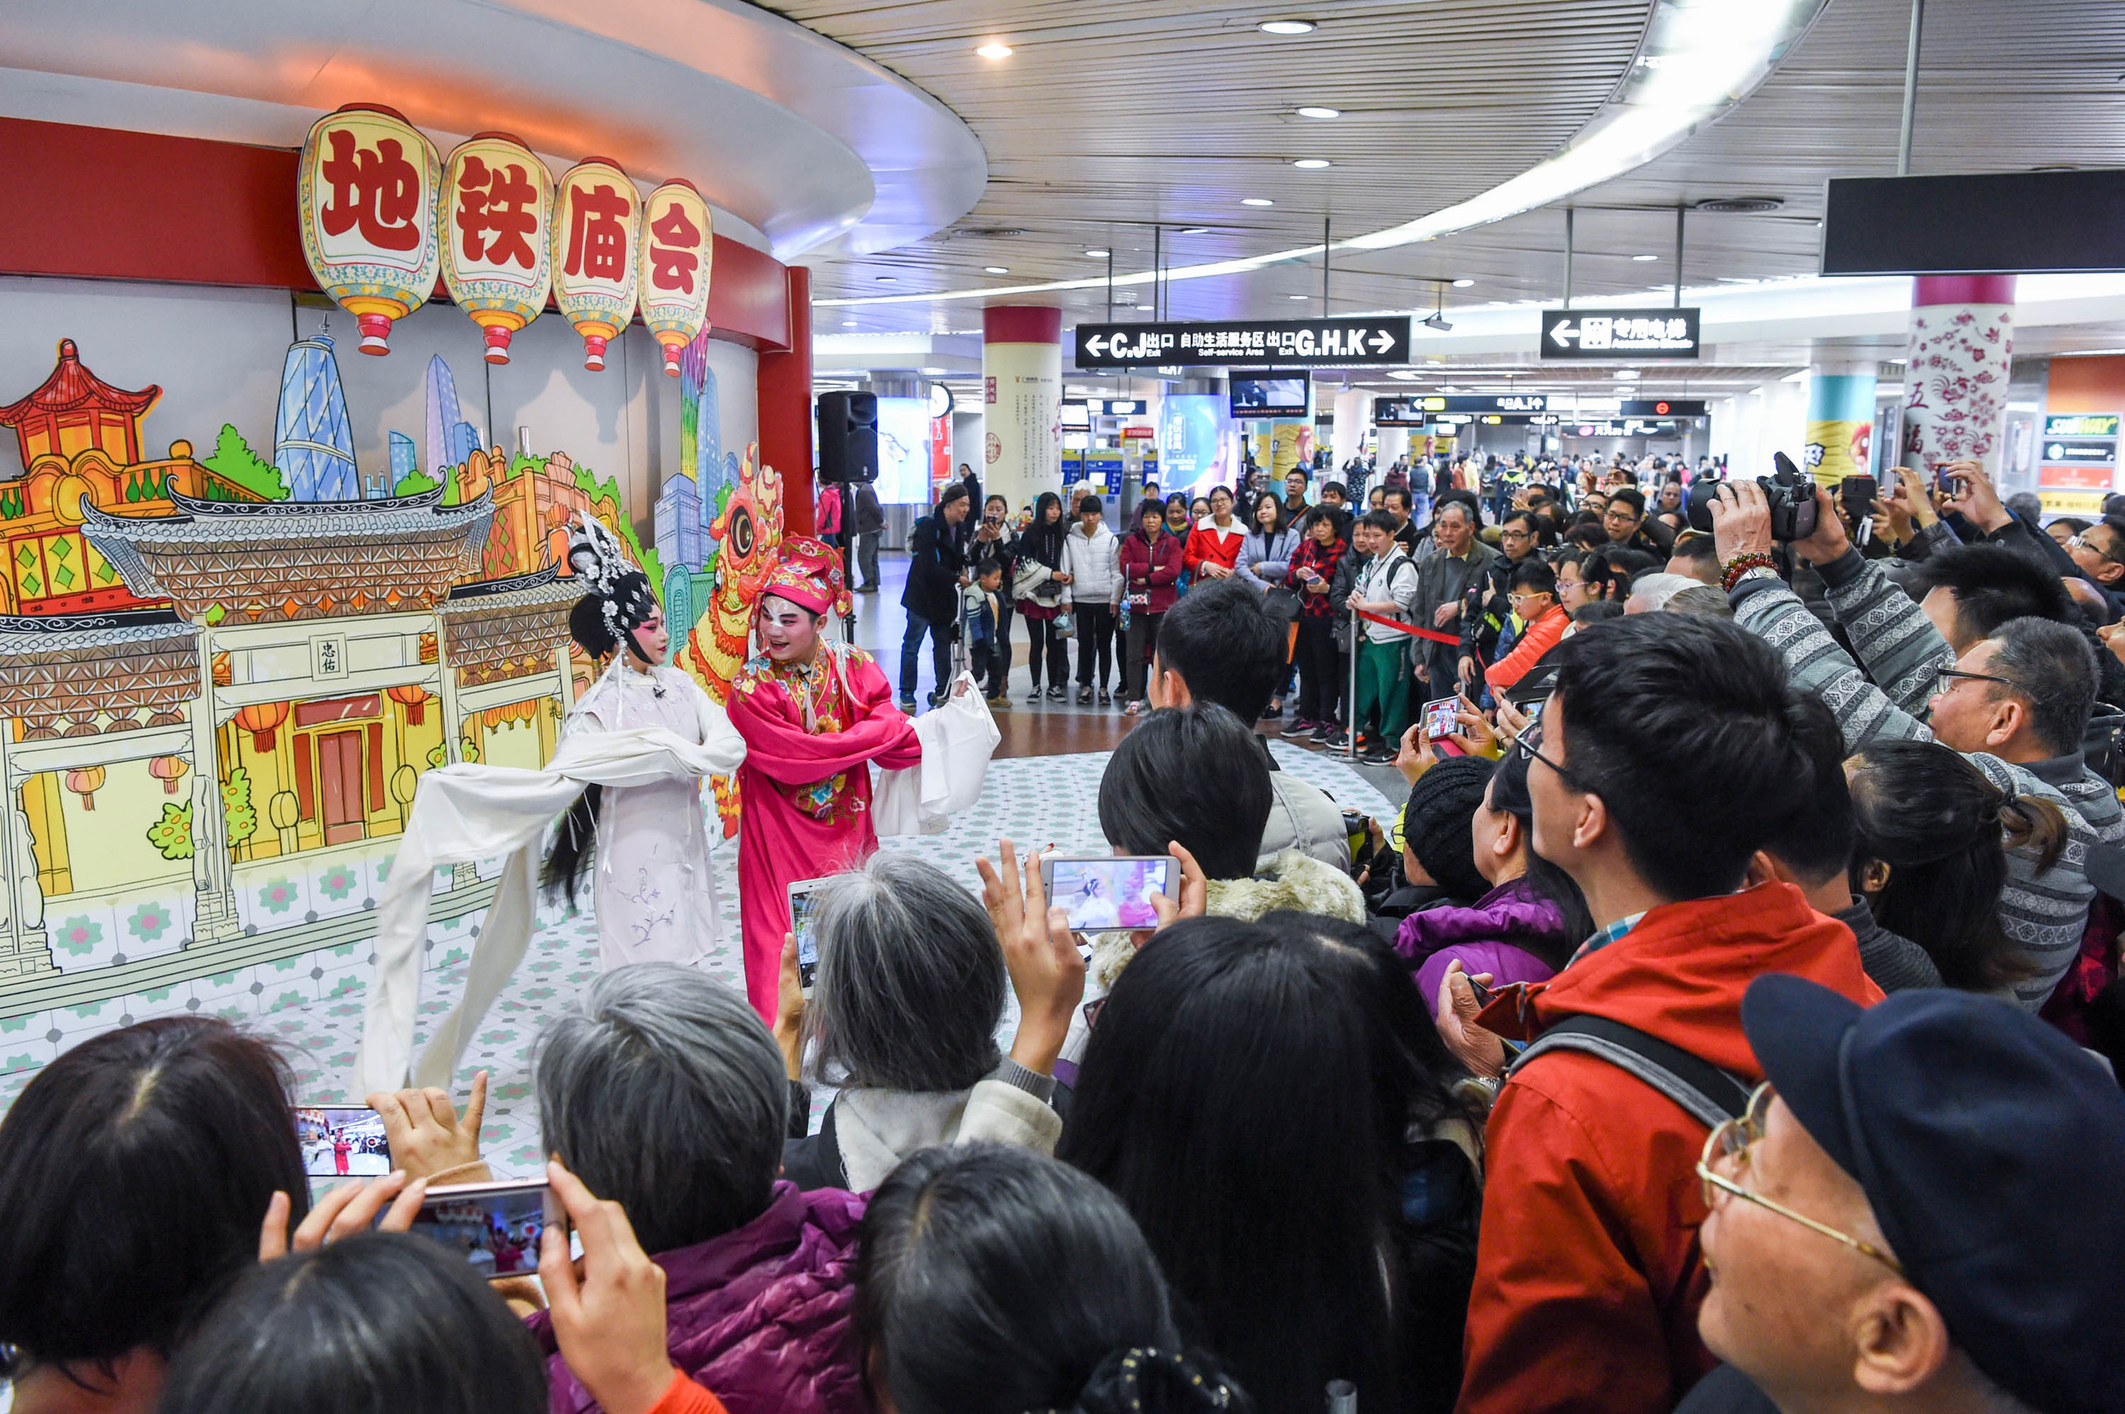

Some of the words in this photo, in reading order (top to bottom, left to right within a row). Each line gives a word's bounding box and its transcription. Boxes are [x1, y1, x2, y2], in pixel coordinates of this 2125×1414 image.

[321, 129, 701, 295] 地铁庙会
[1109, 333, 1147, 358] C.J
[1147, 333, 1174, 348] 出口
[1180, 332, 1265, 348] 自助生活服务区
[1266, 330, 1296, 348] 出口
[1295, 329, 1367, 356] G.H.K
[1146, 349, 1161, 357] Exit
[1198, 348, 1244, 357] Self-service
[1245, 348, 1265, 356] Area
[1278, 347, 1295, 356] Exit
[2047, 416, 2119, 435] SUBWAY
[321, 642, 336, 673] 忠佑
